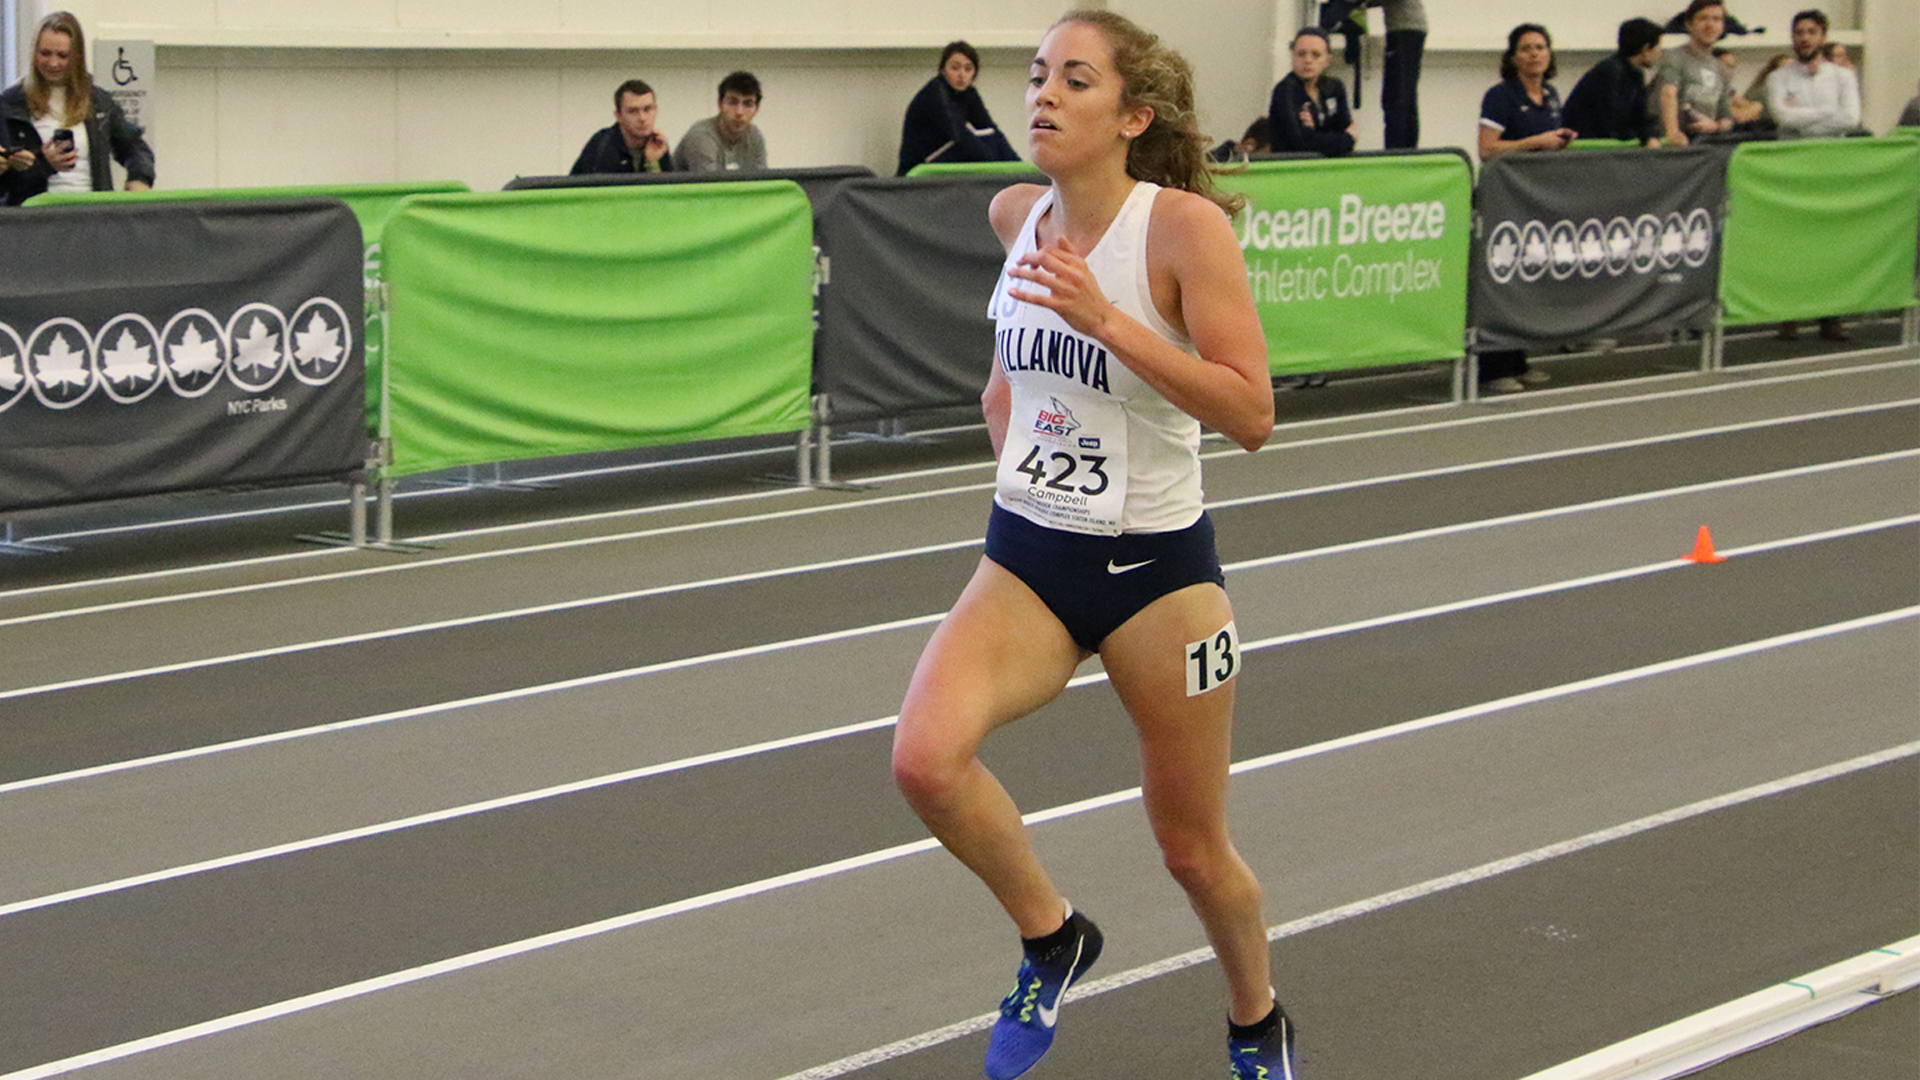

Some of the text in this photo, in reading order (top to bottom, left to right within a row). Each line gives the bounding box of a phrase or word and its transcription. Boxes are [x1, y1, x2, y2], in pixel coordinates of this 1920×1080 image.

[1338, 193, 1446, 245] Breeze
[1246, 250, 1443, 303] thletic Complex
[227, 396, 288, 416] NYC Parks
[1038, 409, 1066, 425] BIG
[1035, 419, 1076, 436] EAST
[1016, 444, 1109, 496] 423
[1027, 487, 1088, 507] Campbell
[1190, 630, 1234, 691] 13
